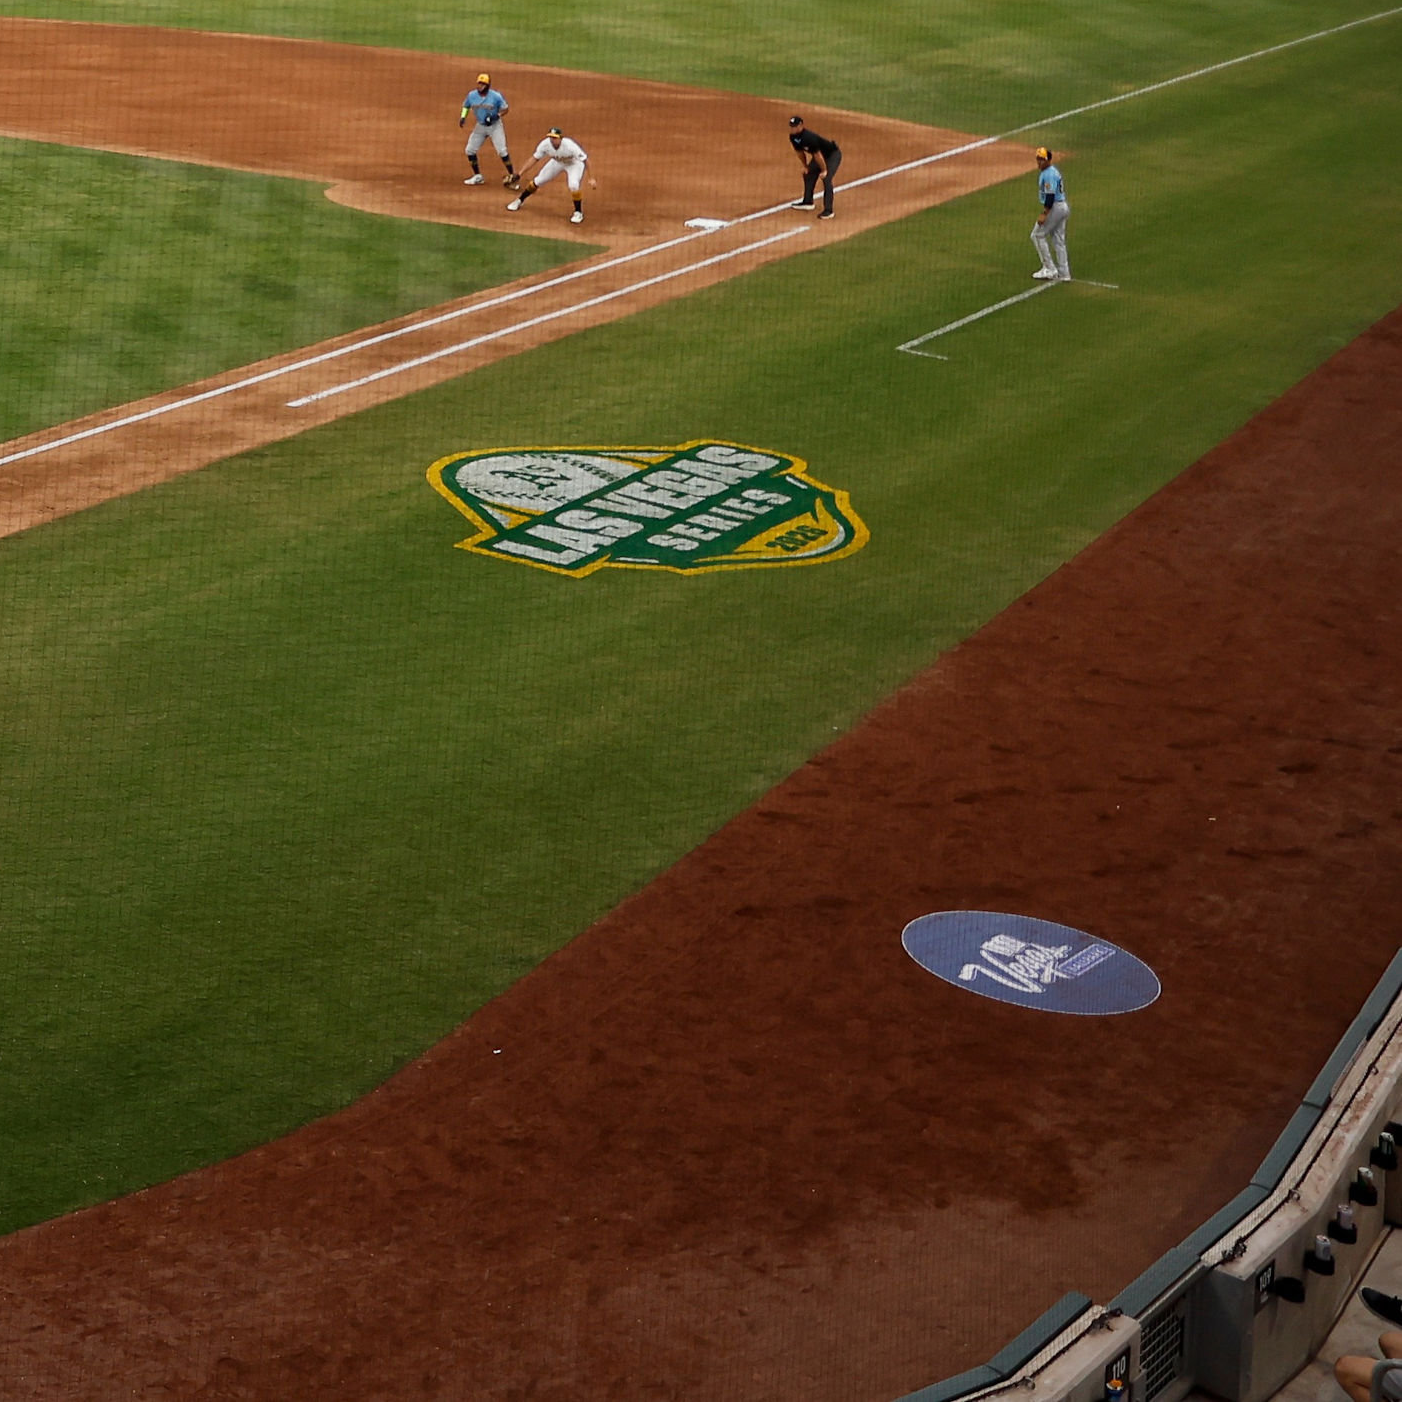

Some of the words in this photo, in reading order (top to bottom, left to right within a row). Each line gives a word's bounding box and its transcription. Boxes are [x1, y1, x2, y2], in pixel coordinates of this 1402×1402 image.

[492, 509, 645, 566] LAS
[596, 444, 782, 520] VEGAS
[646, 487, 793, 552] SERIES
[764, 524, 830, 553] 2026
[1111, 1355, 1127, 1379] 110
